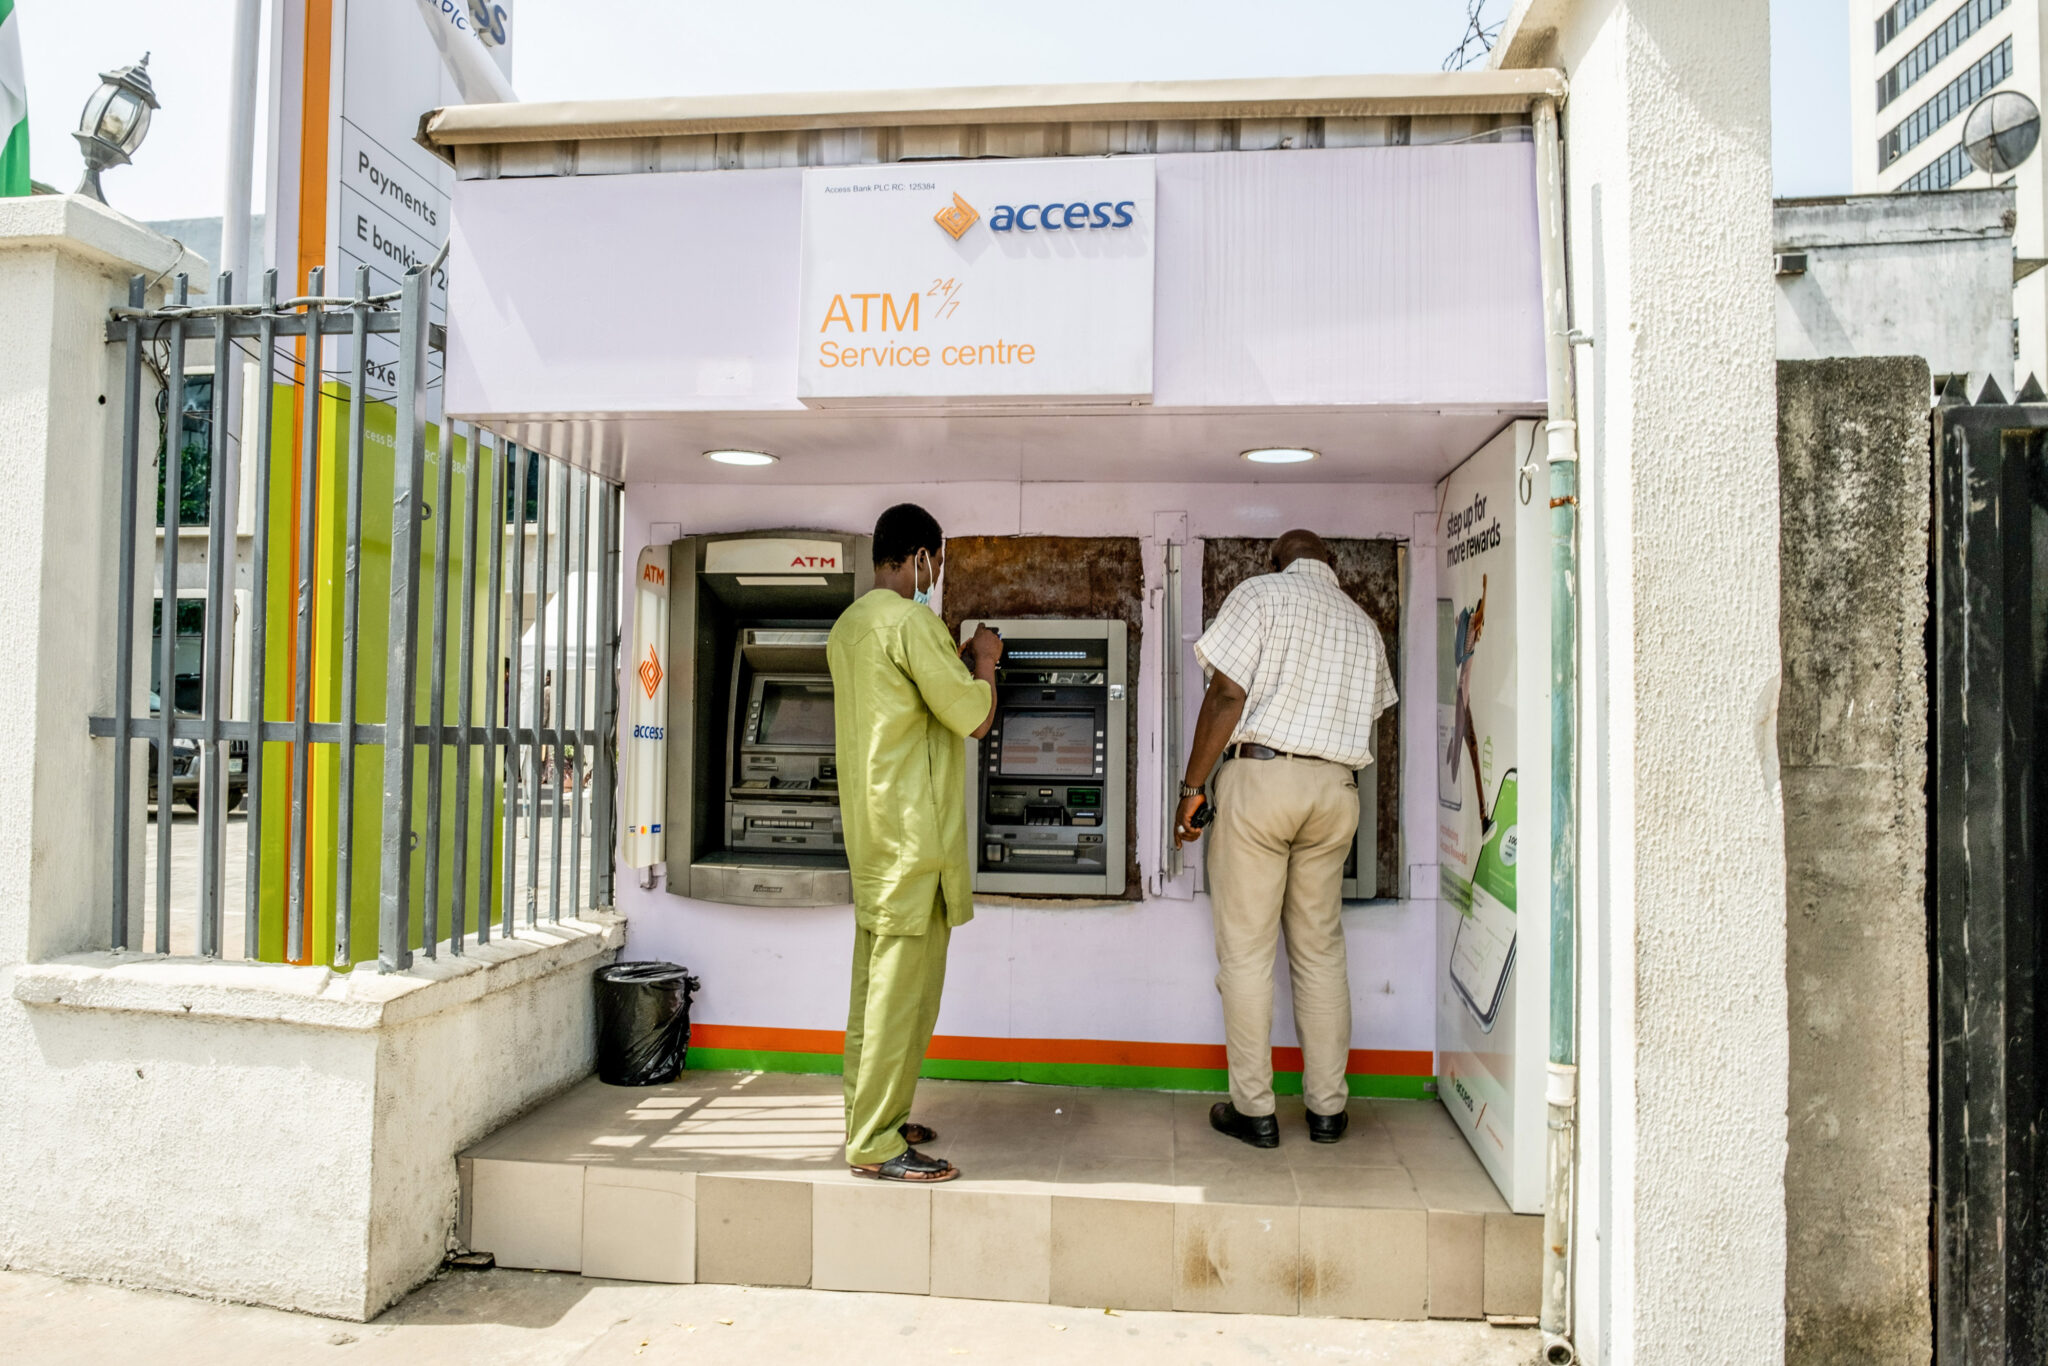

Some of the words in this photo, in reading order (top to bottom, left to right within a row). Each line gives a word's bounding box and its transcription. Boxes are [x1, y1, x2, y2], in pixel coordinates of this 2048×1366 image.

[358, 150, 438, 227] Payments
[824, 185, 851, 194] Access
[853, 184, 872, 193] Bank
[874, 183, 890, 192] PLC
[909, 182, 936, 191] 125384
[357, 214, 368, 242] E
[989, 201, 1135, 232] access
[819, 292, 920, 334] ATM
[818, 340, 931, 368] Service
[941, 338, 1036, 366] centre
[1447, 511, 1463, 541] step
[1463, 505, 1473, 535] up
[1474, 492, 1487, 523] for
[1447, 541, 1465, 568] more
[1466, 516, 1501, 559] rewards
[643, 563, 665, 586] ATM
[790, 556, 836, 568] ATM
[633, 723, 664, 741] access
